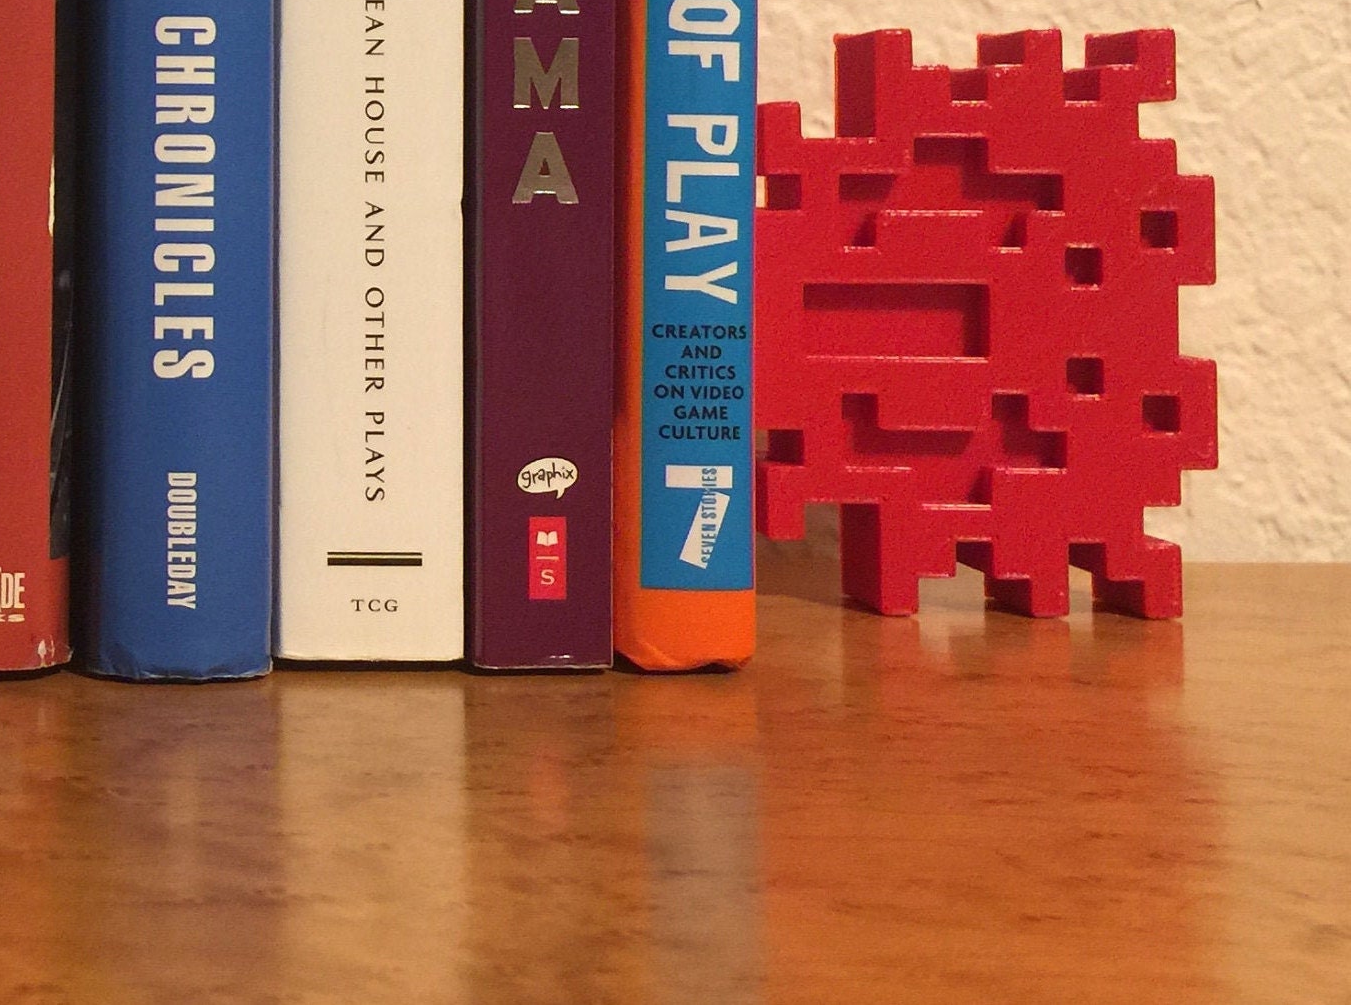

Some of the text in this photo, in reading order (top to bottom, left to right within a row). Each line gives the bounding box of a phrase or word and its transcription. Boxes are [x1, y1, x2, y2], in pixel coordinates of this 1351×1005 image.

[364, 76, 386, 184] HOUSE
[152, 15, 217, 379] CHRONICLES
[664, 115, 739, 305] PLAY
[364, 201, 386, 267] AND
[364, 286, 386, 393] OTHER
[652, 323, 747, 341] CREATORS
[680, 344, 722, 360] AND
[664, 365, 736, 381] CRITICS
[653, 384, 745, 401] ON VIDEO
[674, 405, 729, 421] GAME
[658, 424, 741, 441] CULTURE
[364, 411, 386, 503] PLAYS
[521, 462, 575, 489] graphix
[166, 471, 197, 610] DOUBLEDAY
[351, 598, 399, 613] TCG
